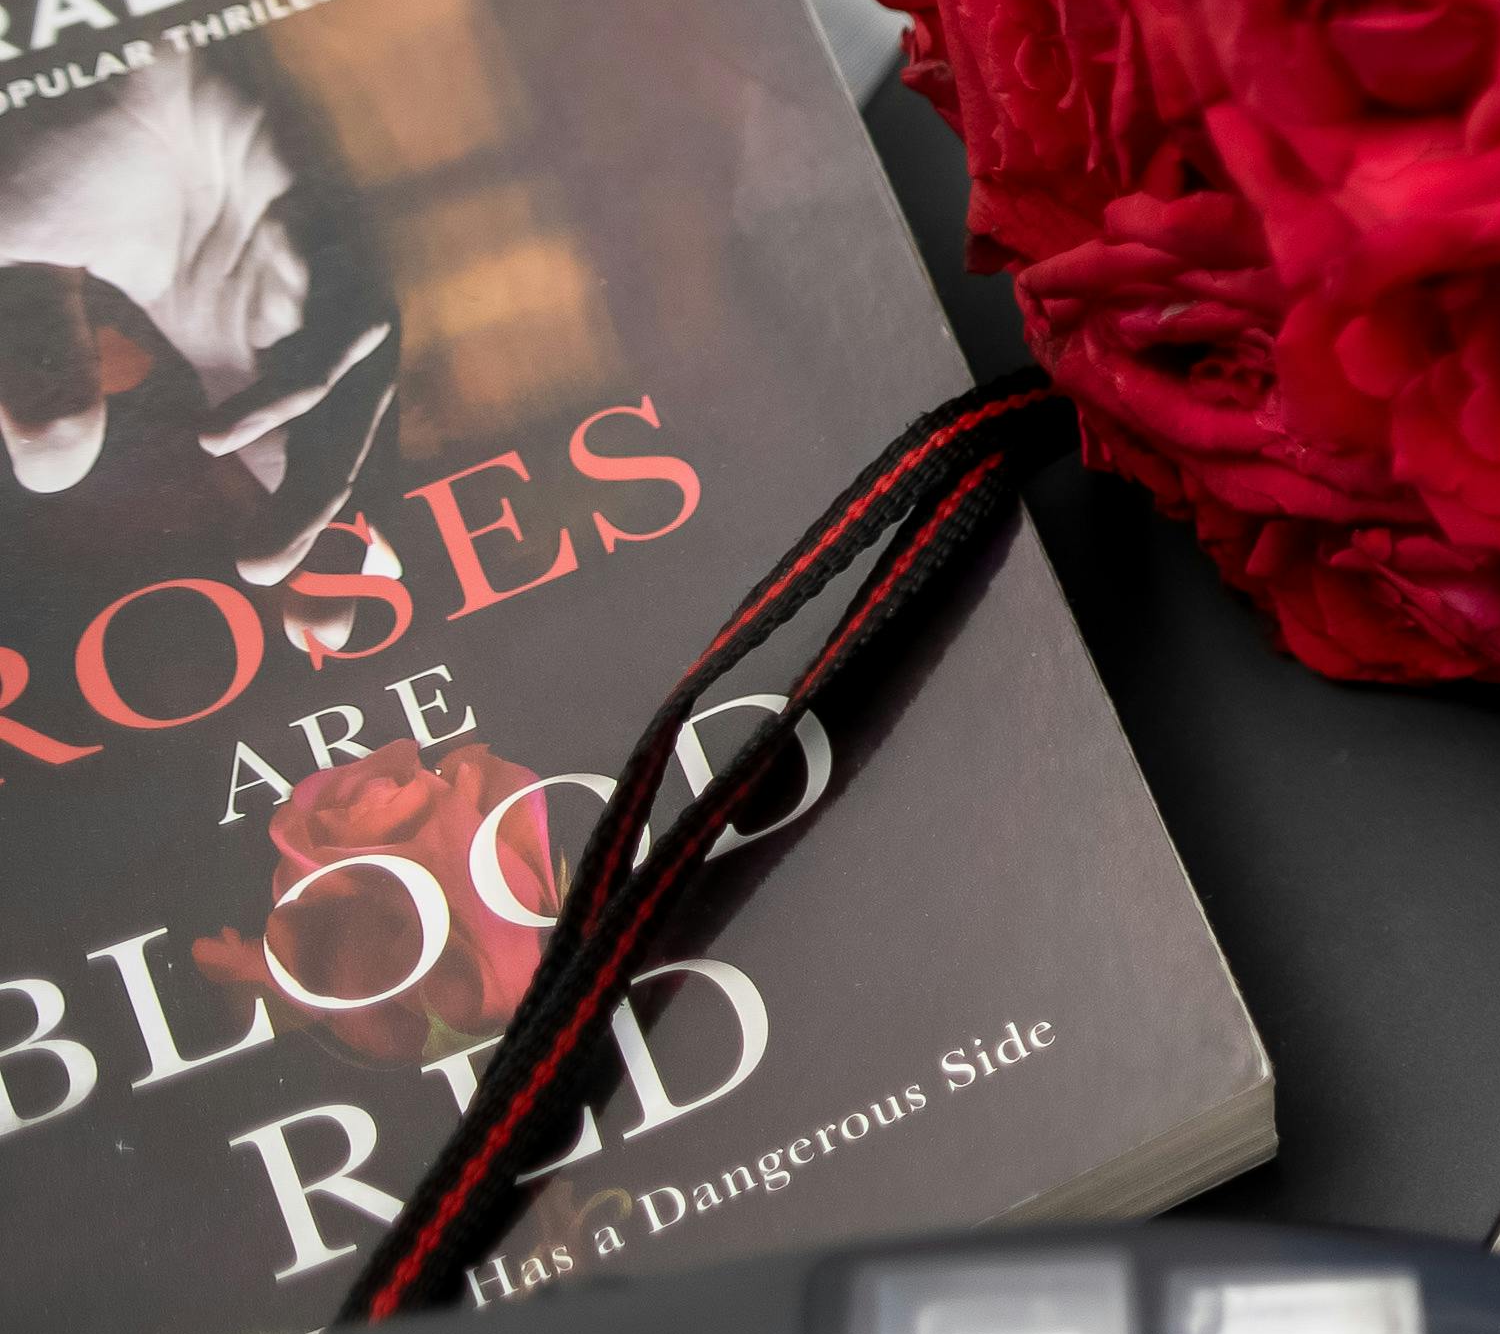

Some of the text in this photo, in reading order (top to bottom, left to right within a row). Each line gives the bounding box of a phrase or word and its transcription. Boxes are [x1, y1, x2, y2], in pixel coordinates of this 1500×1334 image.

[218, 665, 478, 826] ARE
[464, 1016, 1058, 1310] Has a Dangerous Side
